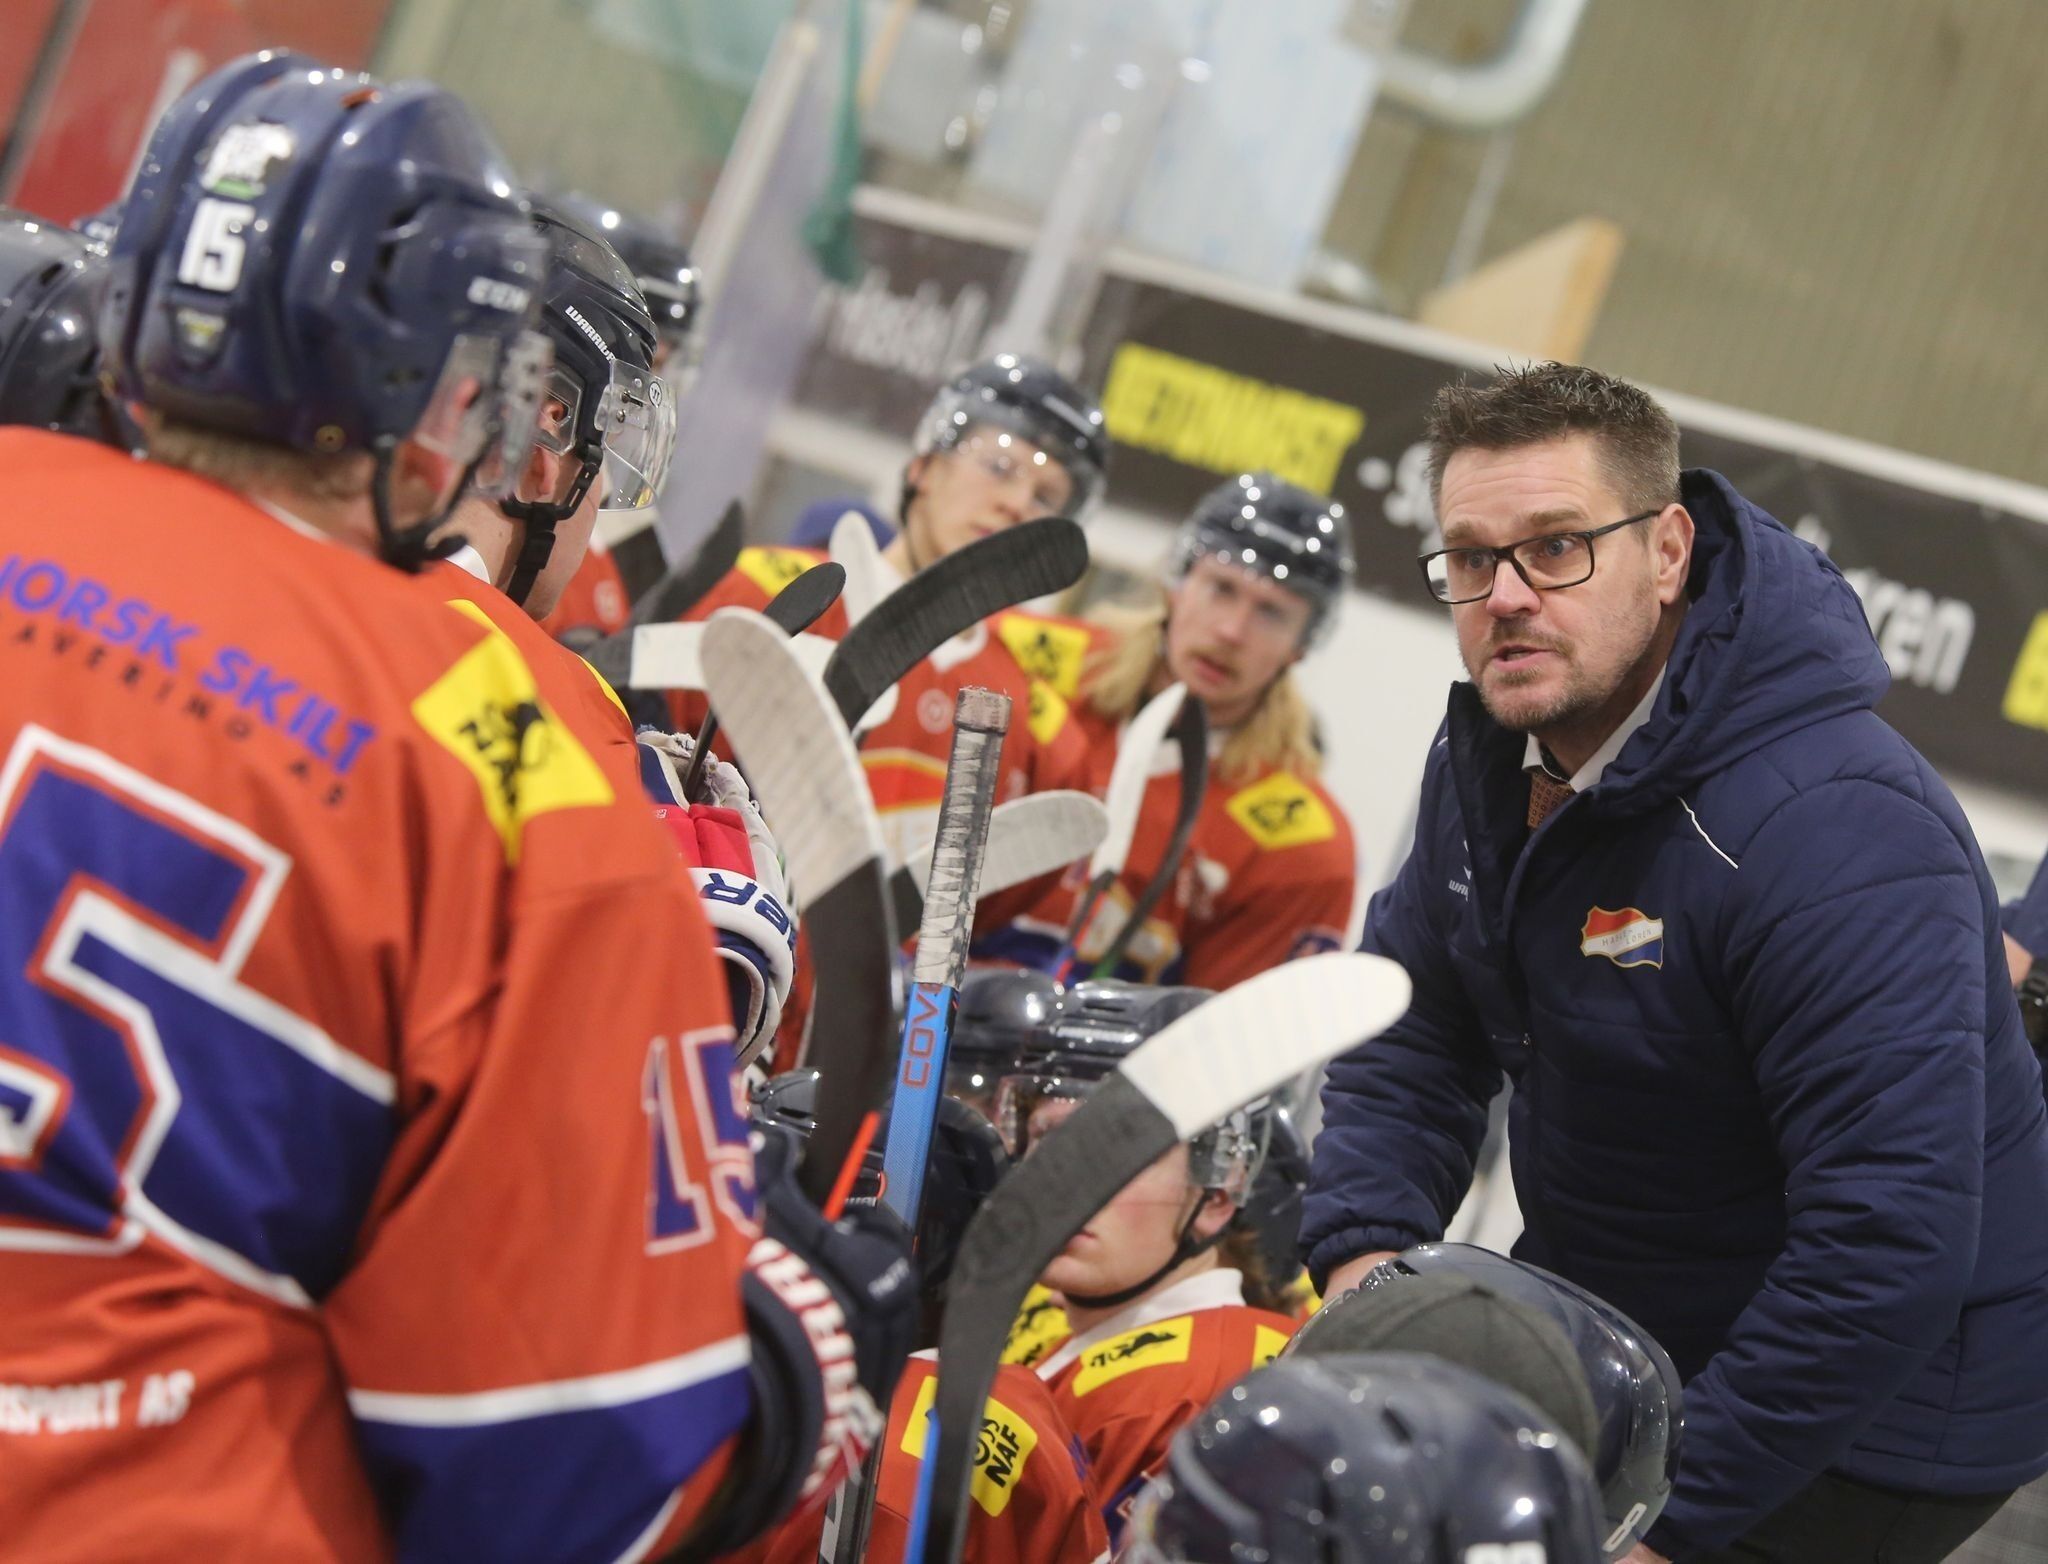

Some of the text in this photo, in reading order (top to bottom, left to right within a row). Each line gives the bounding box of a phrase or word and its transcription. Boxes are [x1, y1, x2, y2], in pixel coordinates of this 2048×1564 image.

[178, 198, 255, 292] 15
[200, 646, 376, 775] SKILT
[903, 983, 943, 1089] COV
[641, 1024, 766, 1257] 15
[984, 1423, 1020, 1489] NAF
